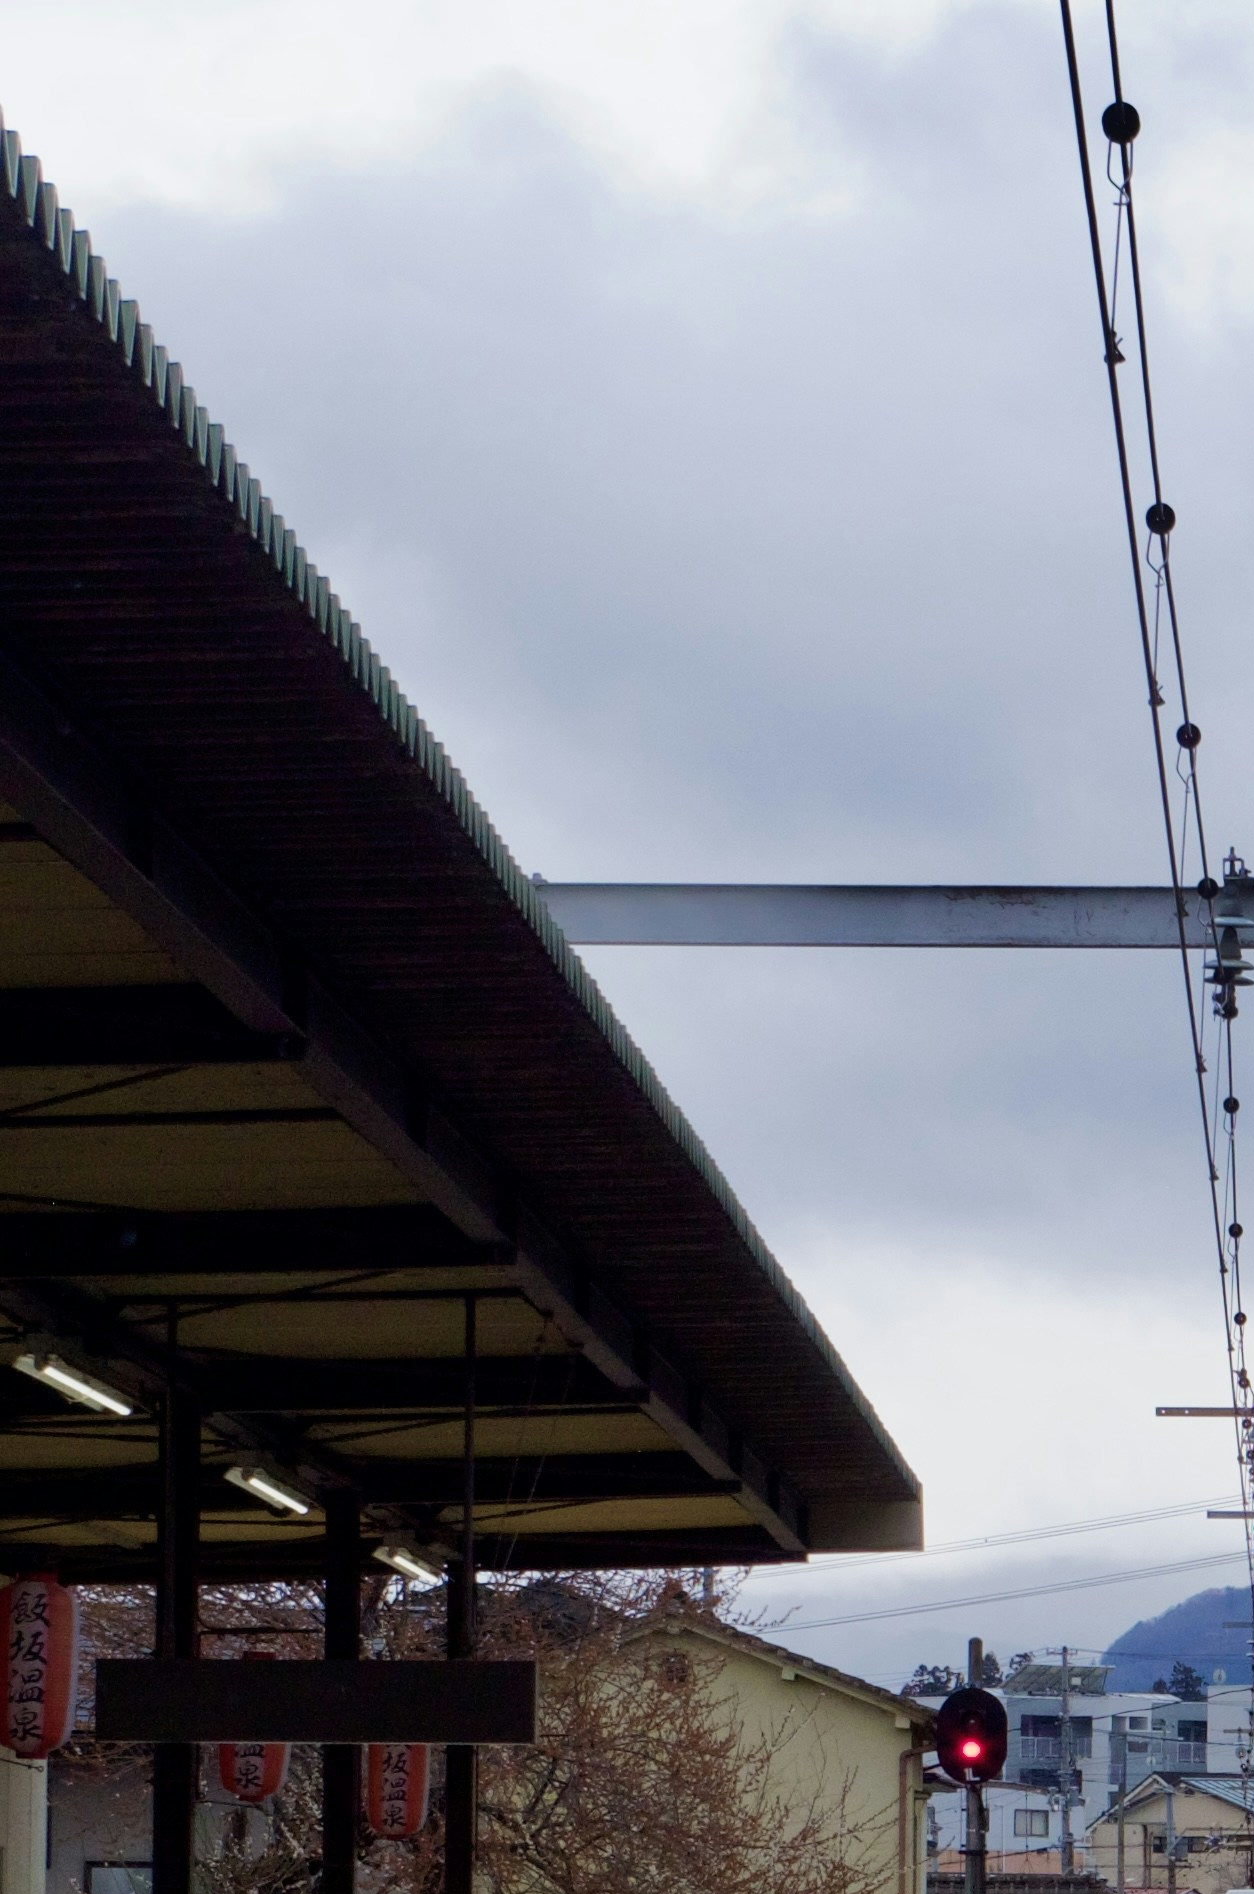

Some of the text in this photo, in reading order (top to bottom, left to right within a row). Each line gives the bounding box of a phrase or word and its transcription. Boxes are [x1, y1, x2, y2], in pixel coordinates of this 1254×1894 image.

[9, 1591, 50, 1741] 飯坂温泉
[380, 1744, 411, 1828] 坂温泉
